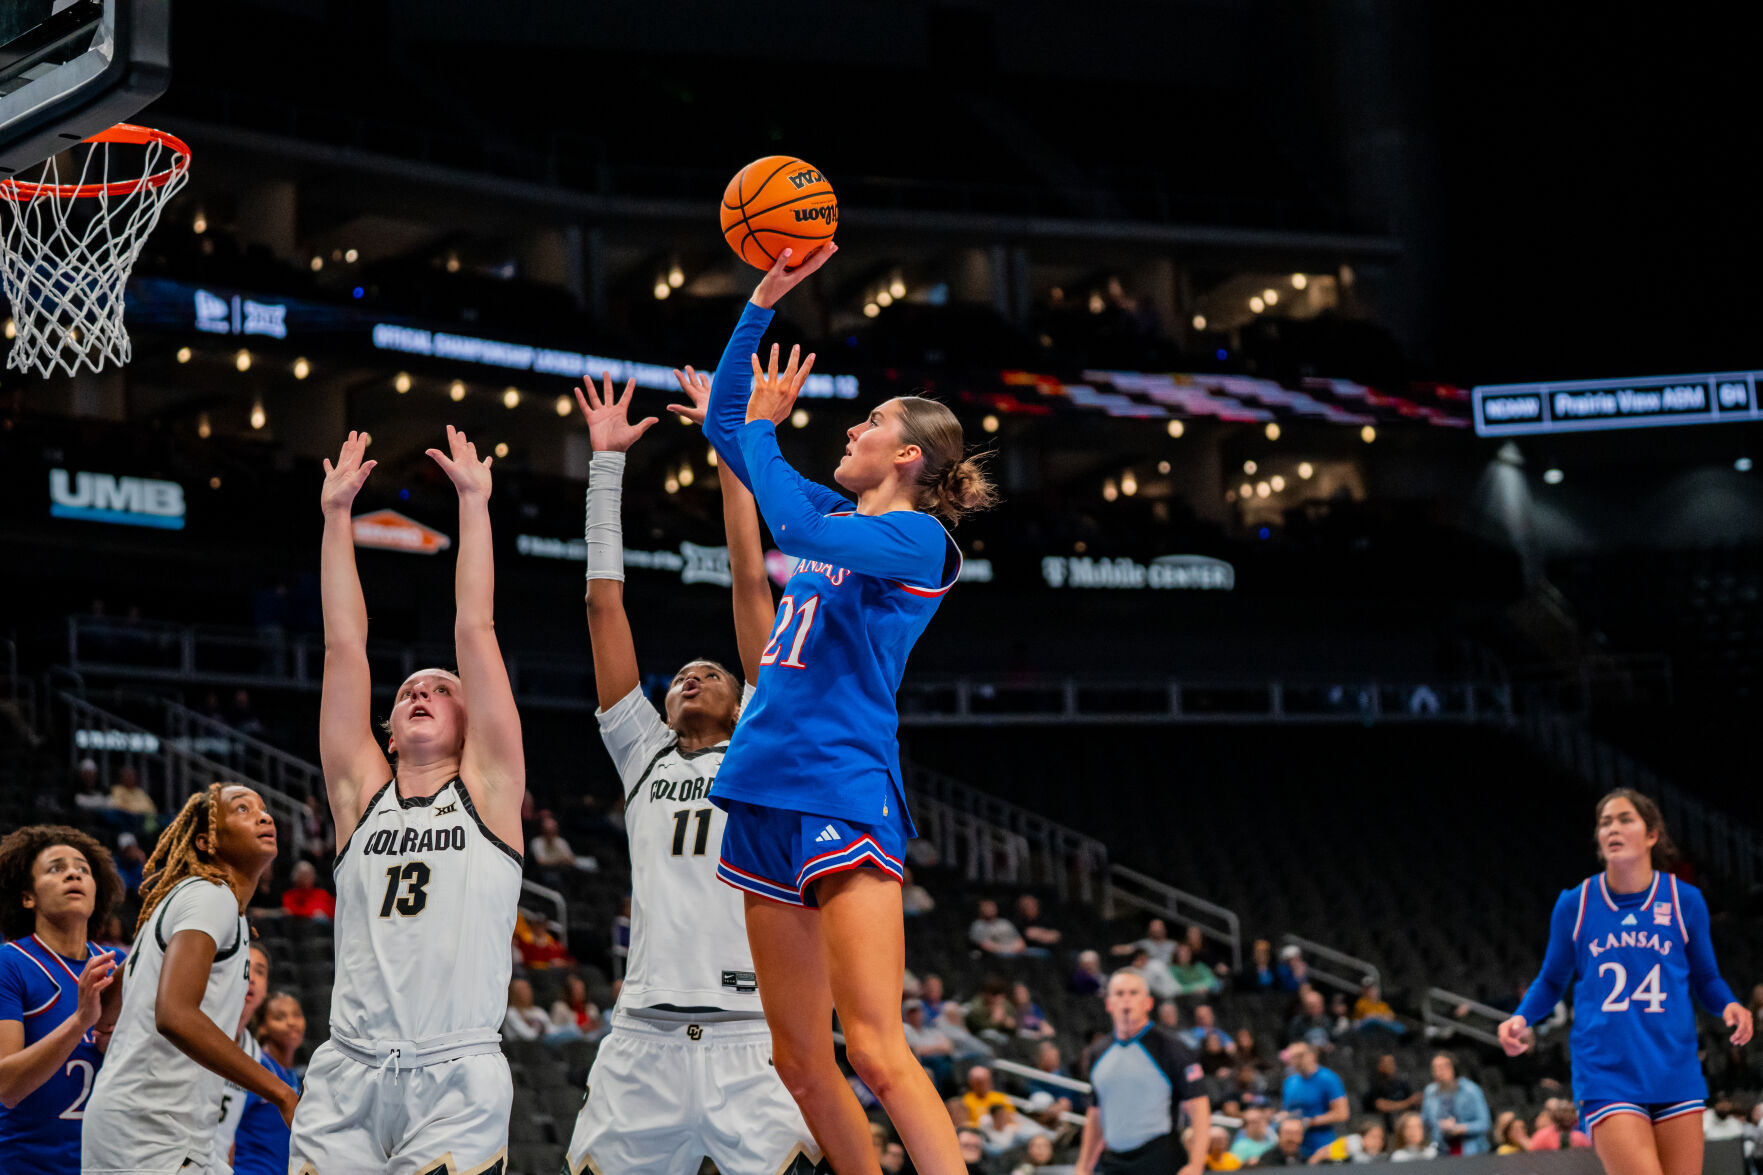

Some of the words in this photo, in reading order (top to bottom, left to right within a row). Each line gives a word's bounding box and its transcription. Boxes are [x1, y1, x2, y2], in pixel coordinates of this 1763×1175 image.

[1554, 392, 1618, 417] Prairie
[1617, 389, 1661, 413] View
[50, 468, 186, 516] UMB
[793, 558, 852, 587] ANSAS
[760, 594, 820, 670] 21
[671, 808, 714, 857] 11
[379, 861, 432, 919] 13
[1588, 931, 1673, 958] KANSAS
[1598, 961, 1668, 1014] 24
